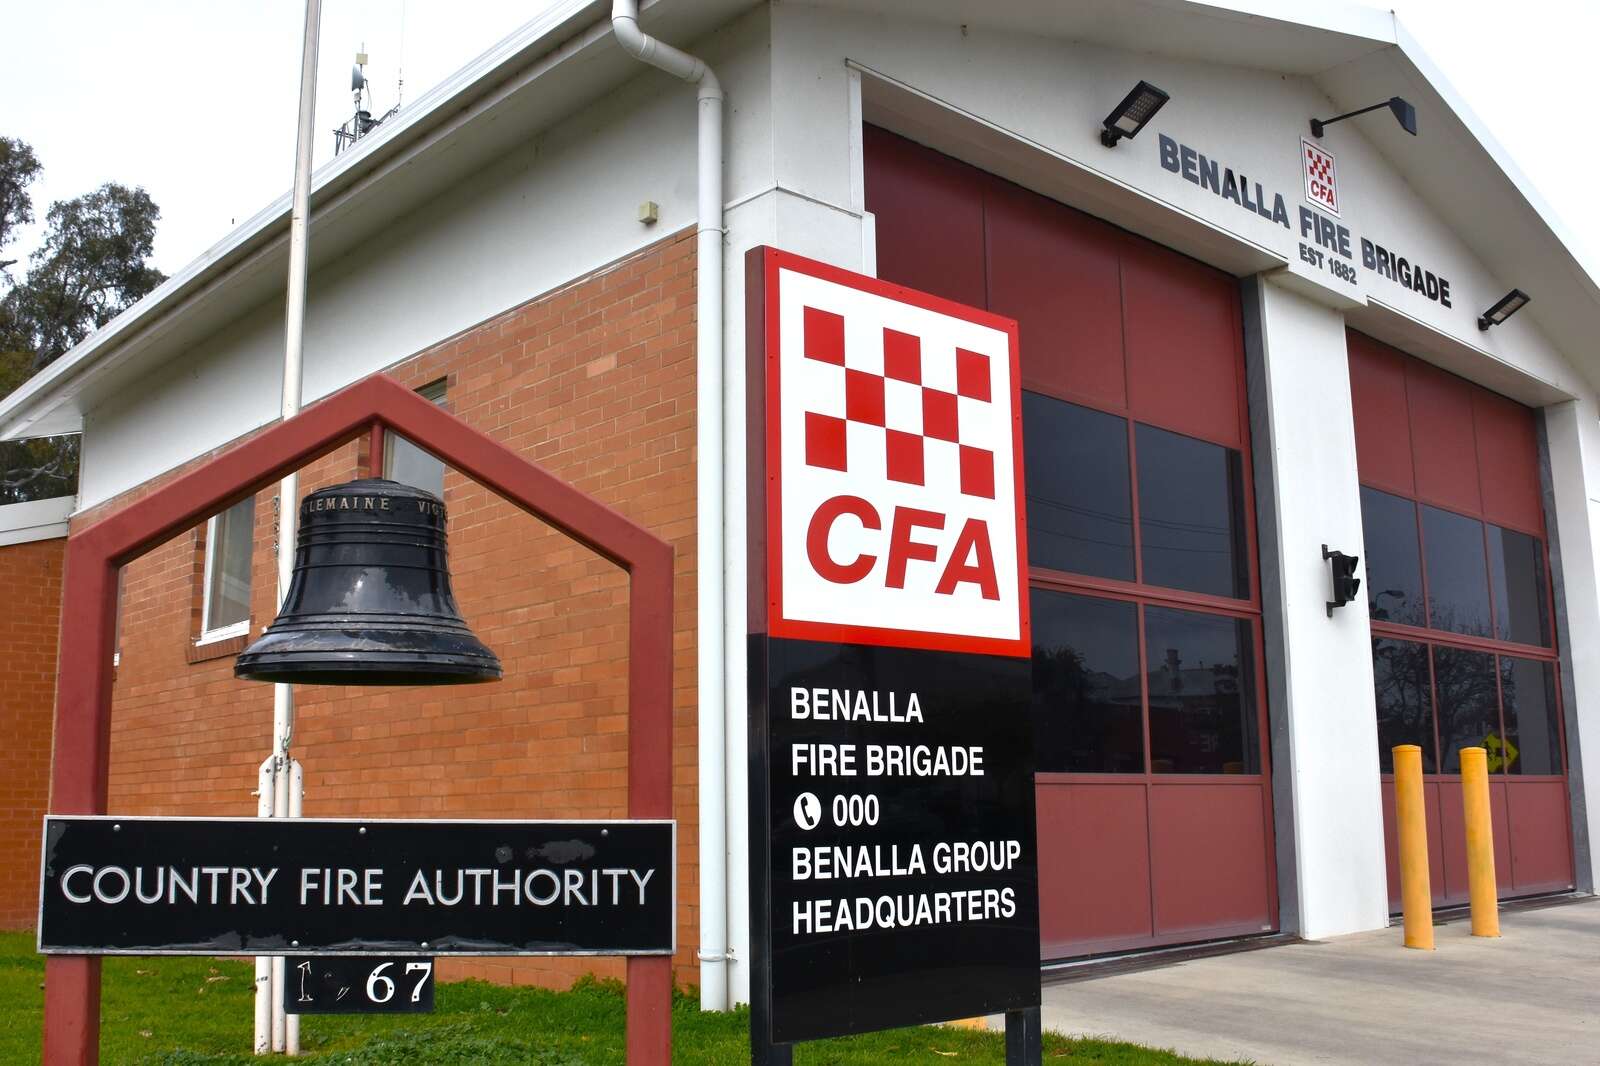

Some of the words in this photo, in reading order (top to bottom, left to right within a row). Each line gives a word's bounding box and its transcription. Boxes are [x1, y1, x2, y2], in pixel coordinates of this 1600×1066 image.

[1310, 180, 1335, 206] CFA
[1158, 133, 1291, 230] BENALLA
[1299, 205, 1353, 260] FIRE
[1361, 237, 1453, 309] BRIGADE
[1299, 242, 1325, 270] EST
[1328, 257, 1358, 286] 1882
[303, 497, 390, 513] LEMAINE
[806, 494, 1001, 602] CFA
[790, 686, 924, 723] BENALLA
[792, 743, 858, 776] FIRE
[866, 744, 985, 777] BRIGADE
[832, 794, 880, 827] 000
[792, 843, 927, 881] BENALLA
[932, 839, 1022, 875] GROUP
[60, 863, 279, 905] COUNTRY
[300, 868, 384, 906] FIRE
[402, 868, 655, 906] AUTHORITY
[792, 887, 1017, 935] HEADQUARTERS
